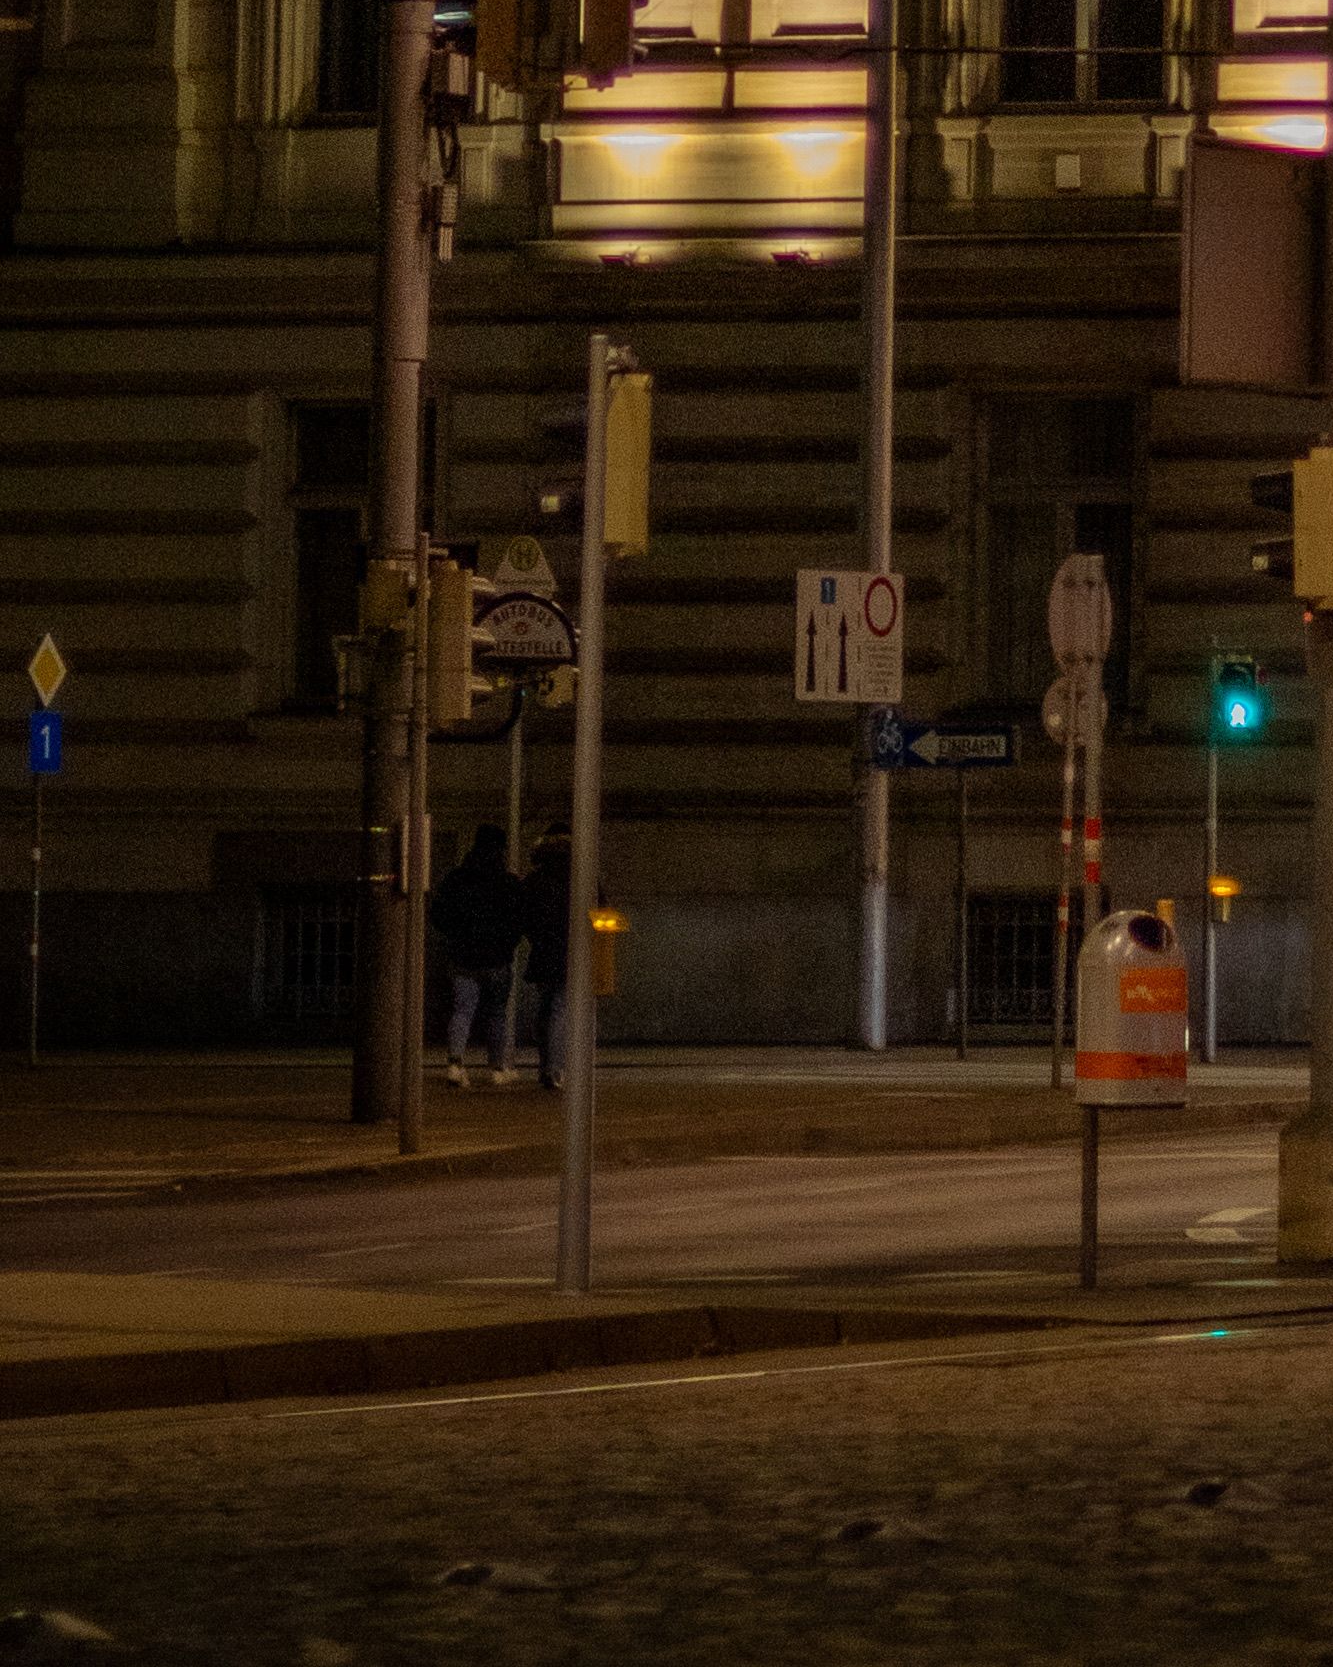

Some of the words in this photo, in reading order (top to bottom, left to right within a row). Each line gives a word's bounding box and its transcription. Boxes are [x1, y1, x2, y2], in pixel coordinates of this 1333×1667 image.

[492, 602, 556, 629] AUTOBUS
[39, 724, 51, 760] 1
[938, 737, 1001, 755] EINBAHN
